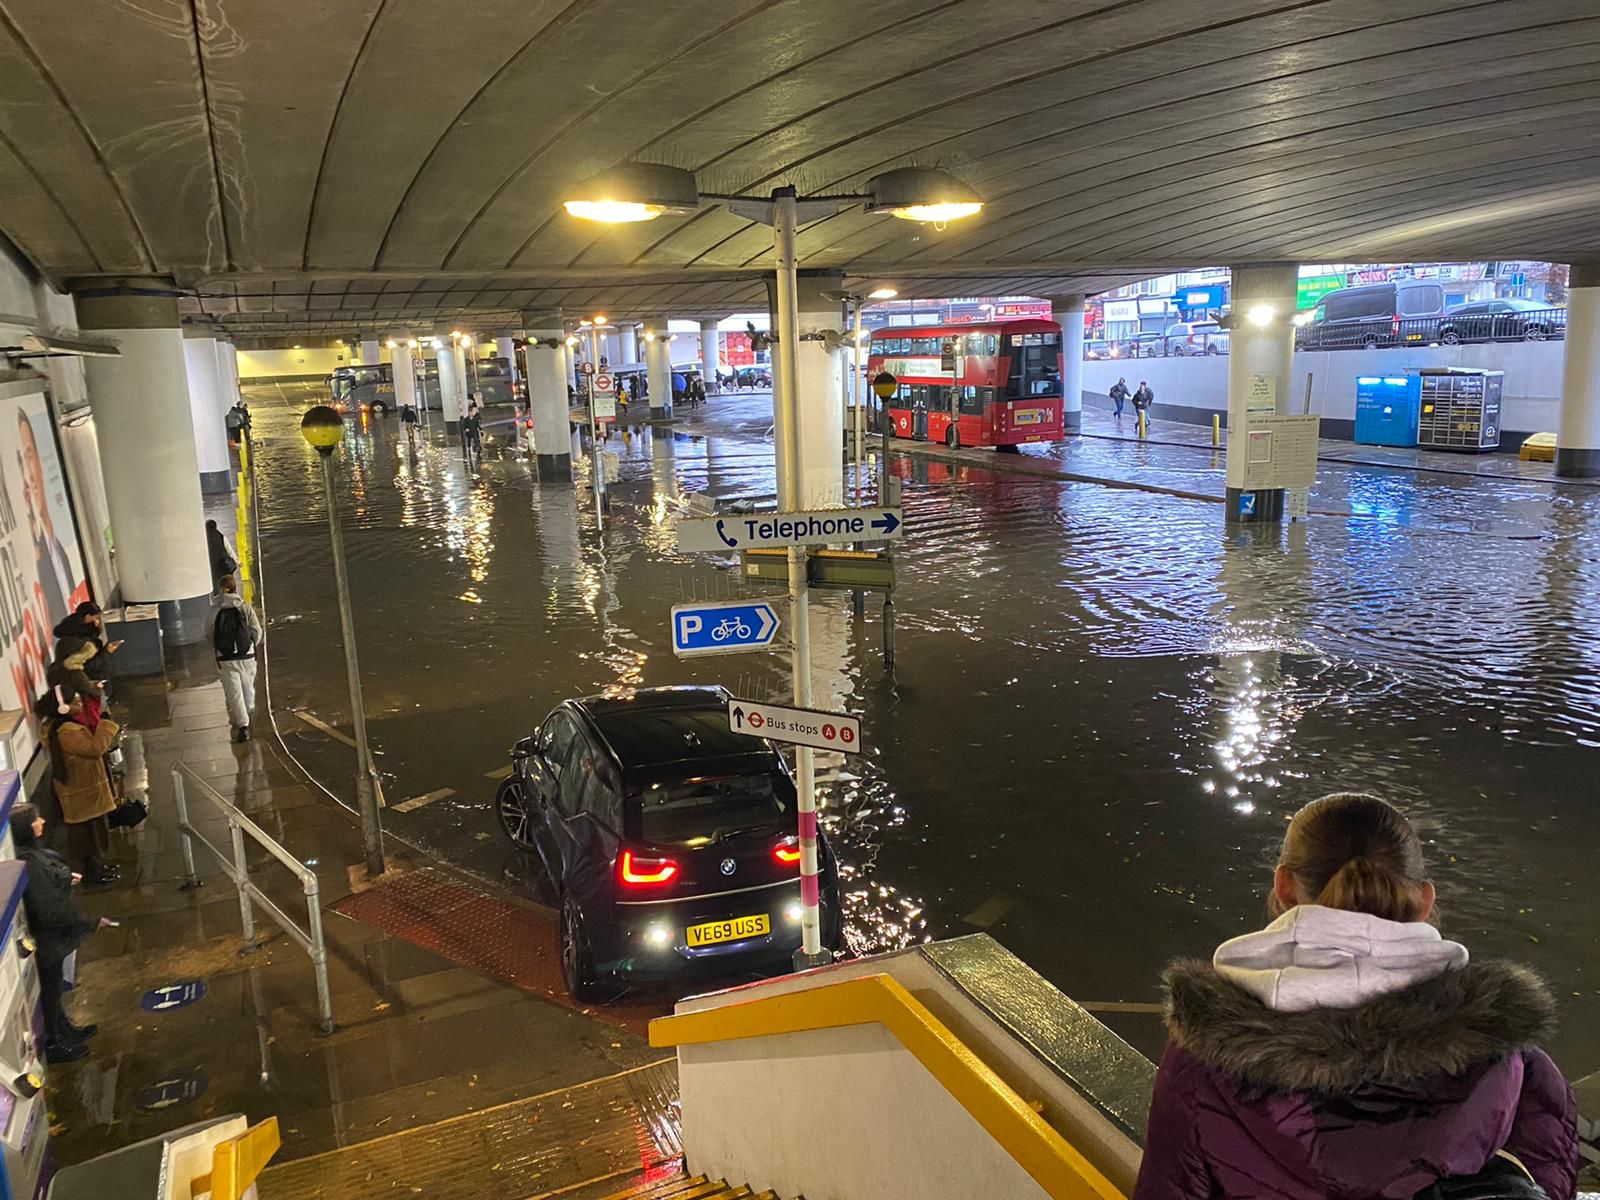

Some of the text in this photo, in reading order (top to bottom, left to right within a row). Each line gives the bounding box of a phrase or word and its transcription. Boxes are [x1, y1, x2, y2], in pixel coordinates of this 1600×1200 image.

[744, 516, 865, 541] Telephone
[680, 615, 702, 645] P
[767, 717, 786, 730] Bus
[789, 721, 818, 735] stops
[694, 918, 764, 942] VE69 USS
